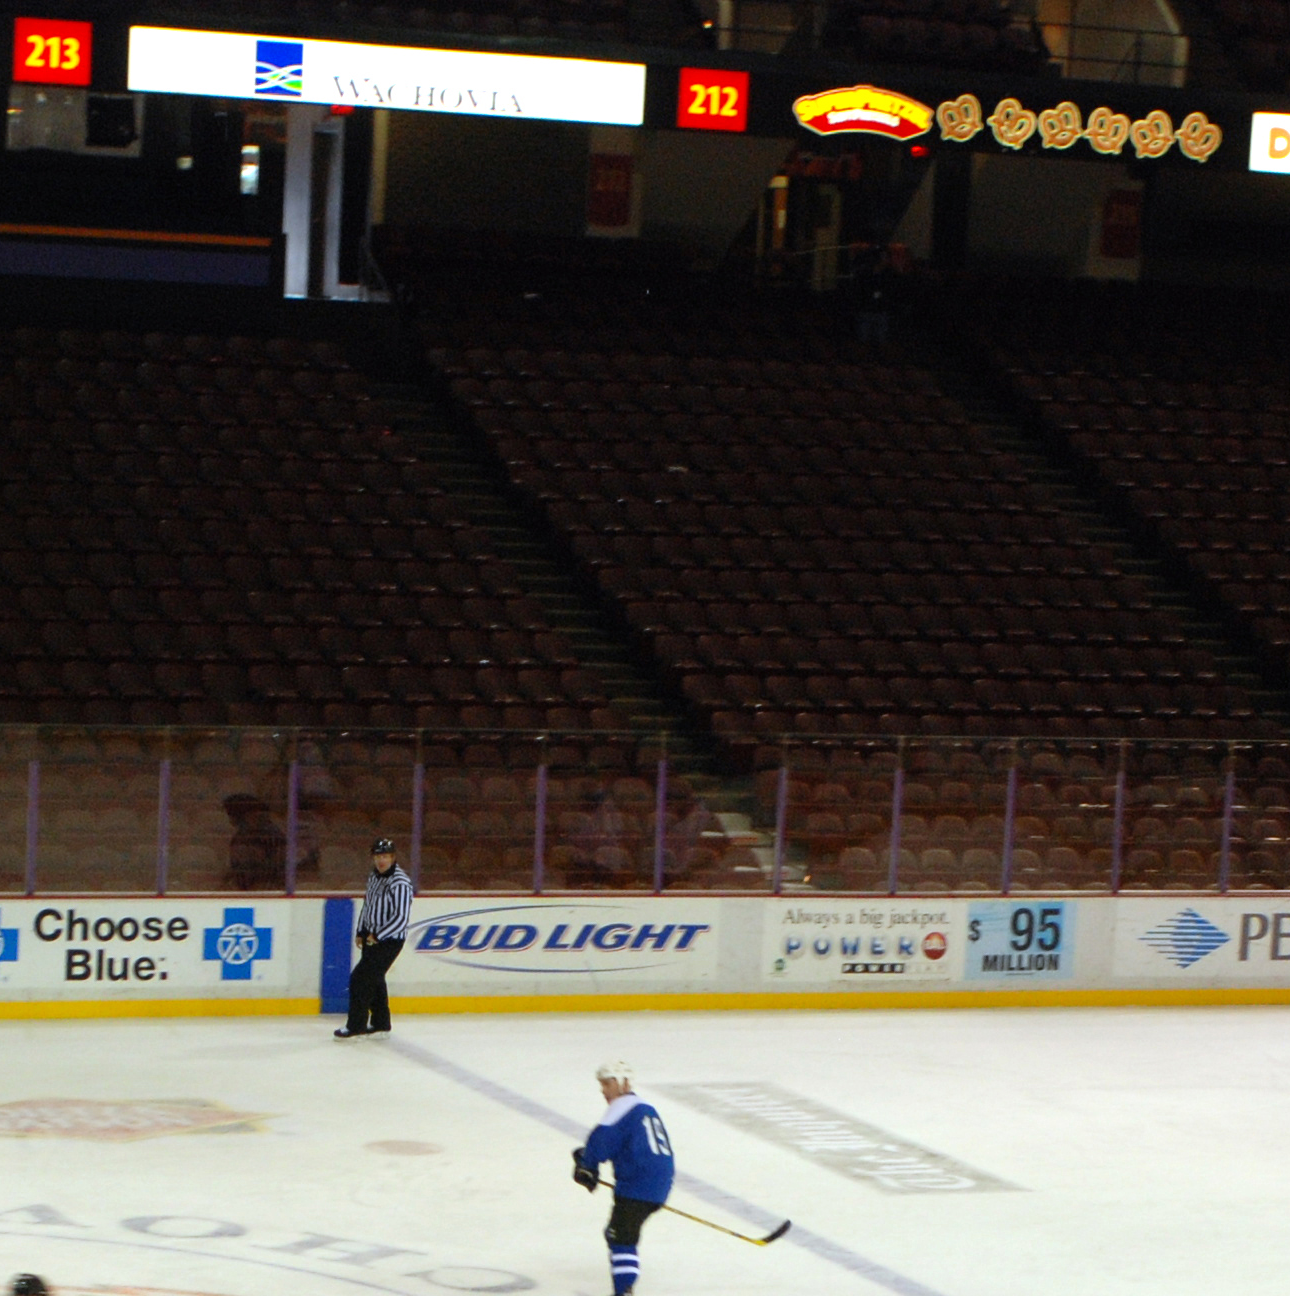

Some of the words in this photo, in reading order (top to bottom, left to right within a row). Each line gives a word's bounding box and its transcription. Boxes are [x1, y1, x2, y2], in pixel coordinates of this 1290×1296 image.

[25, 35, 80, 70] 213
[332, 76, 523, 113] WACHOVIA
[687, 84, 739, 117] 212
[33, 908, 191, 942] Choose
[782, 908, 841, 928] Always
[845, 912, 855, 926] a
[859, 908, 884, 928] big
[968, 919, 981, 942] $
[1010, 907, 1062, 952] 95
[415, 923, 539, 954] BUD
[542, 923, 710, 953] LIGHT
[981, 954, 1060, 973] MILLION
